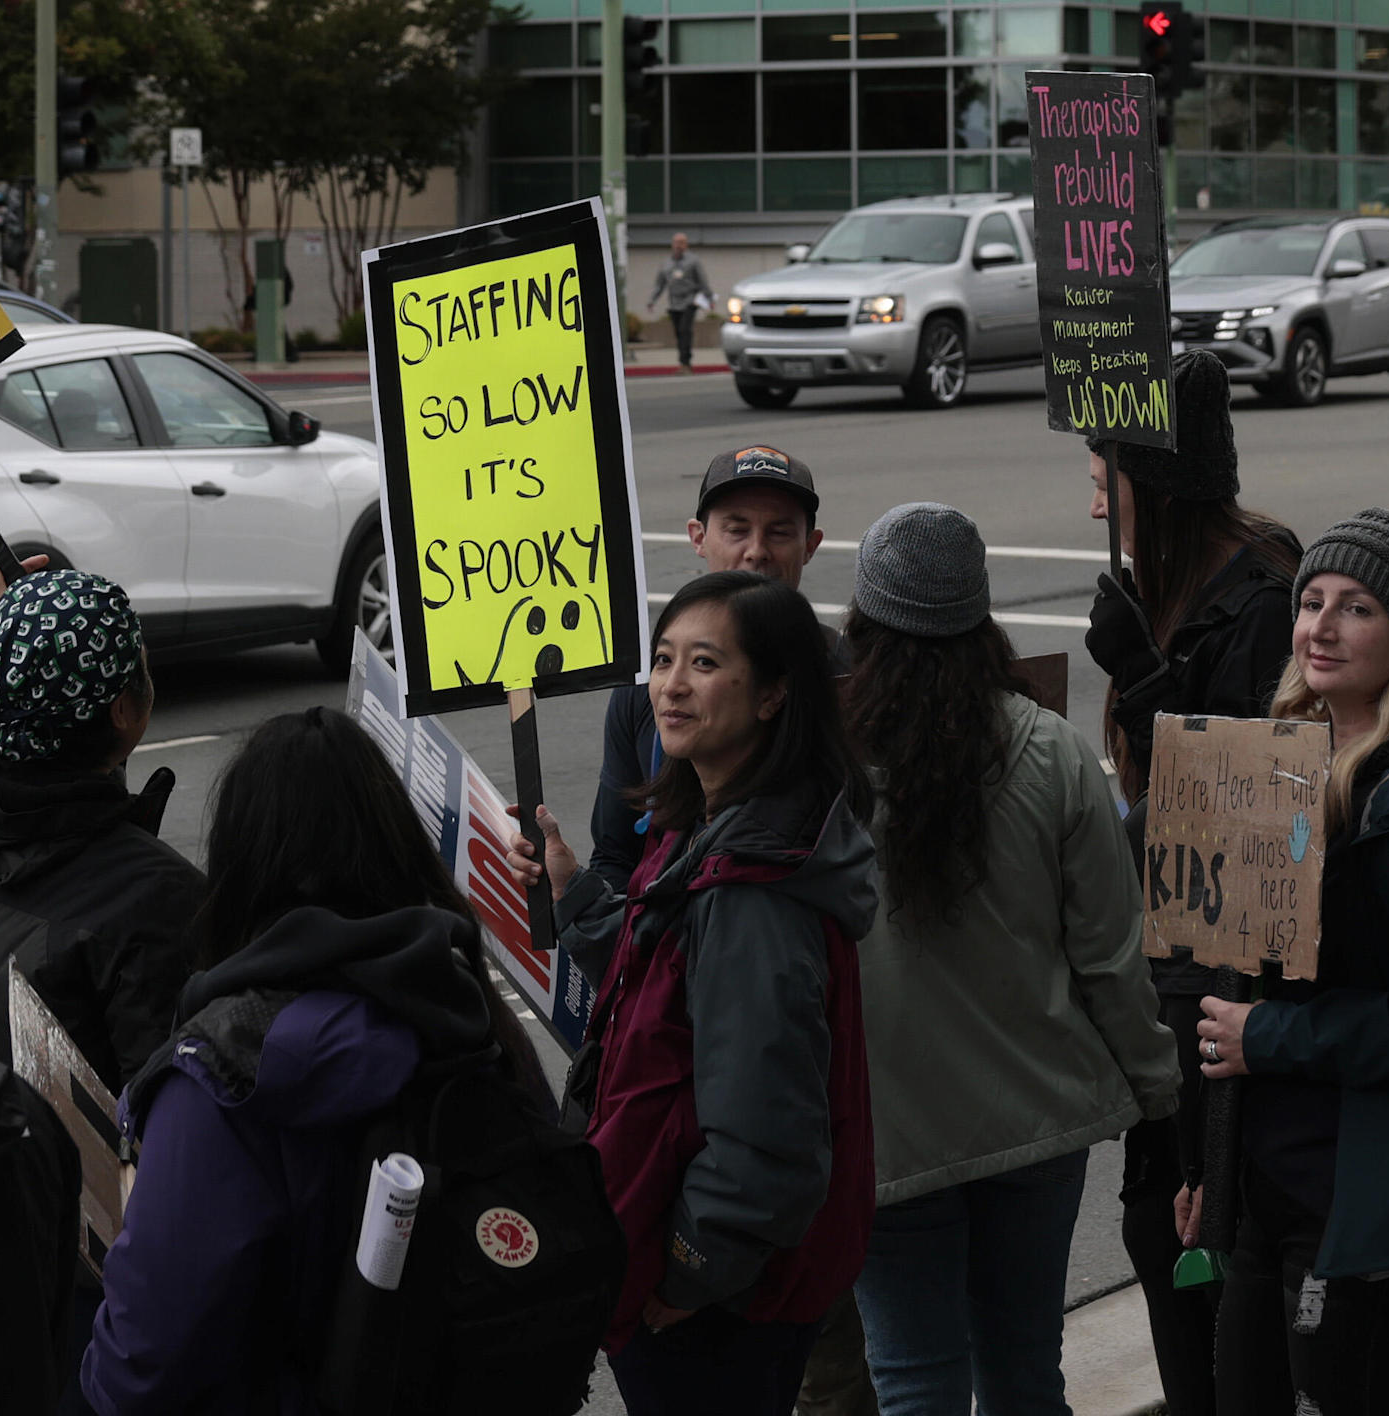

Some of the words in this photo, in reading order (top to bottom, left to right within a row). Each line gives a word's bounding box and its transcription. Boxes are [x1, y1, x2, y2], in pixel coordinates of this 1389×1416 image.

[1031, 80, 1140, 160] Therapists
[1054, 149, 1135, 215] rebuild
[1064, 220, 1135, 278] LIVES
[399, 268, 583, 366] STAFFING
[1052, 313, 1135, 348] management
[1090, 349, 1149, 376] Breaking
[420, 395, 469, 440] SO
[483, 365, 583, 430] LOW
[1067, 376, 1097, 429] US
[1101, 379, 1170, 432] DOWN
[465, 456, 545, 501] IT'S
[422, 524, 602, 610] SPOOKY
[1155, 752, 1209, 814] We're
[1213, 751, 1256, 815] Here
[1268, 757, 1282, 811] 4
[1288, 762, 1319, 809] the
[1147, 841, 1225, 926] KIDS
[1260, 872, 1298, 911] here
[1238, 911, 1250, 958] 4
